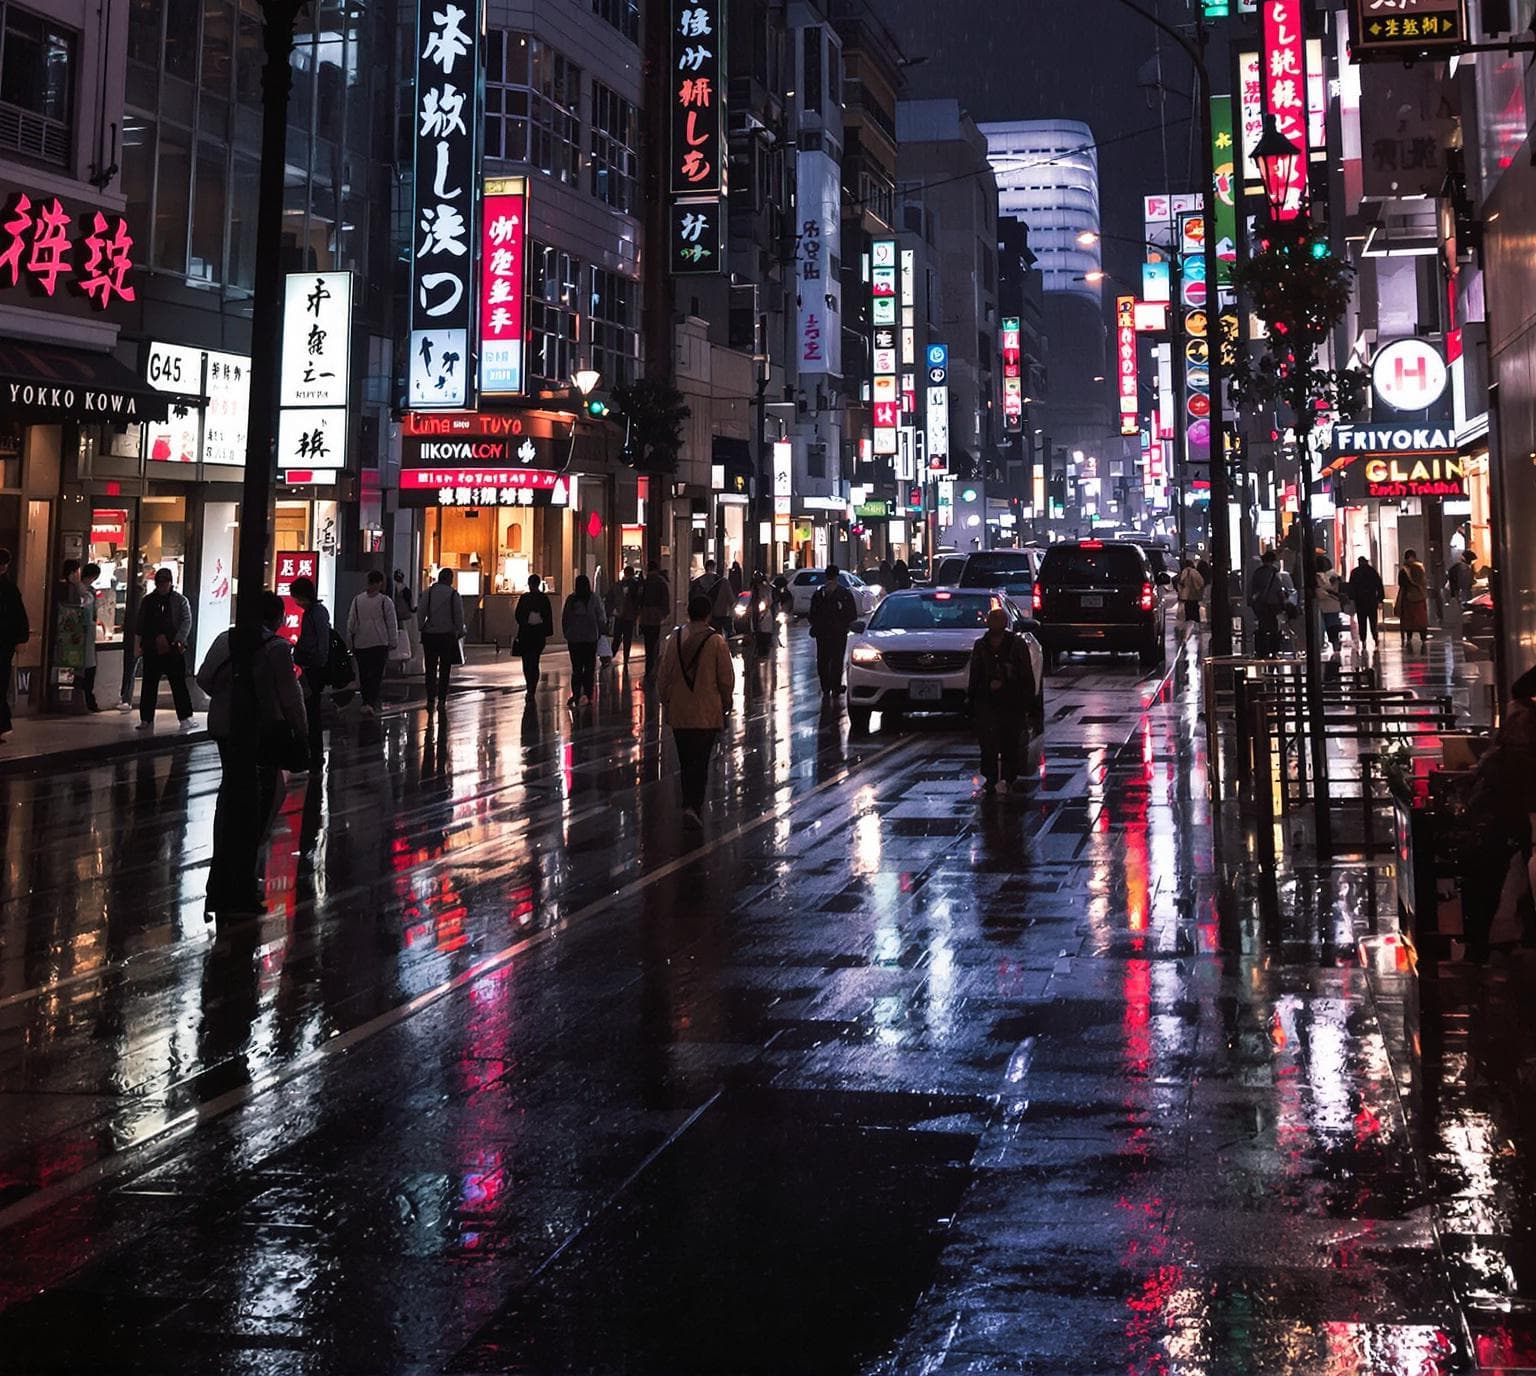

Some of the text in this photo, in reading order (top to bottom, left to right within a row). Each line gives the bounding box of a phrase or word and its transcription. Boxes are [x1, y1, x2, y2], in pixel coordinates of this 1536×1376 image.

[150, 353, 182, 382] G45
[10, 383, 137, 415] YOKKO KOWA
